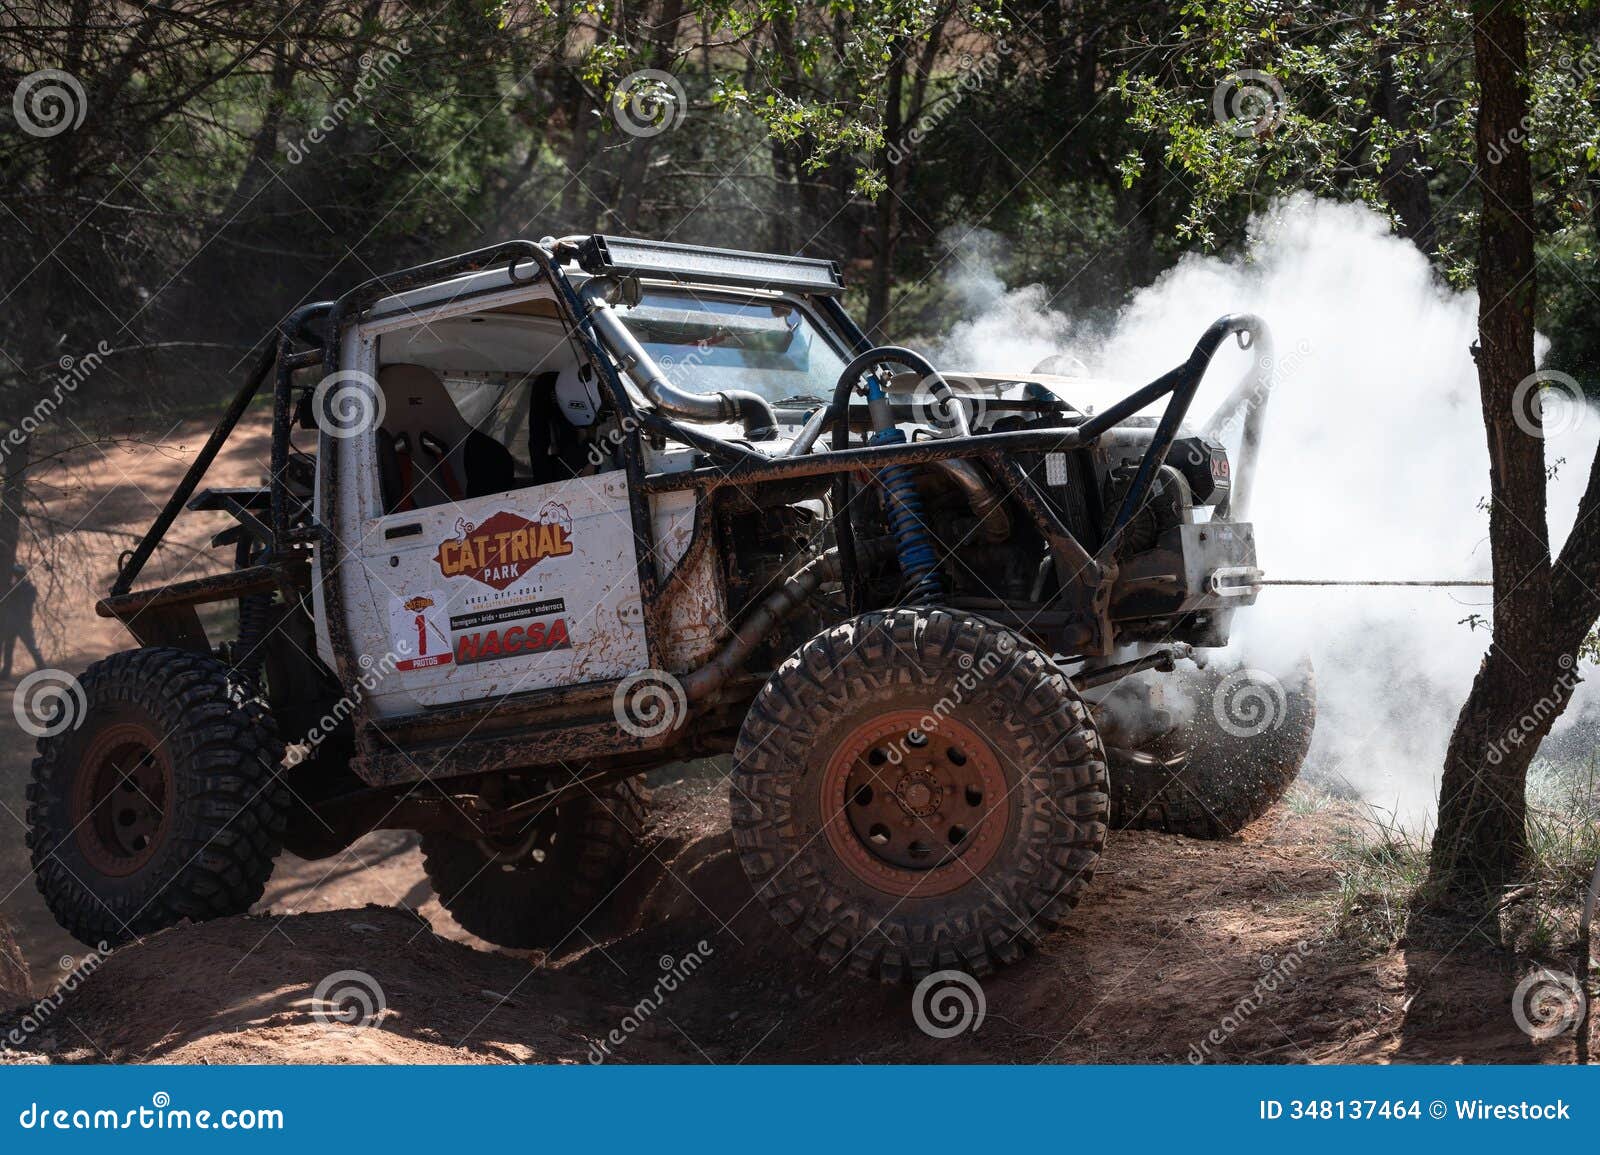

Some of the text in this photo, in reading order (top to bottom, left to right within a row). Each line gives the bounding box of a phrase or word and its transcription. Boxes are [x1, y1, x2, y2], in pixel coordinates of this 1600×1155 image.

[1211, 458, 1230, 478] X9
[441, 523, 573, 574] CAT-TRIAL
[483, 563, 520, 583] PARK
[414, 614, 427, 656] 1
[457, 618, 569, 665] NACSA
[412, 656, 438, 669] PROTOS
